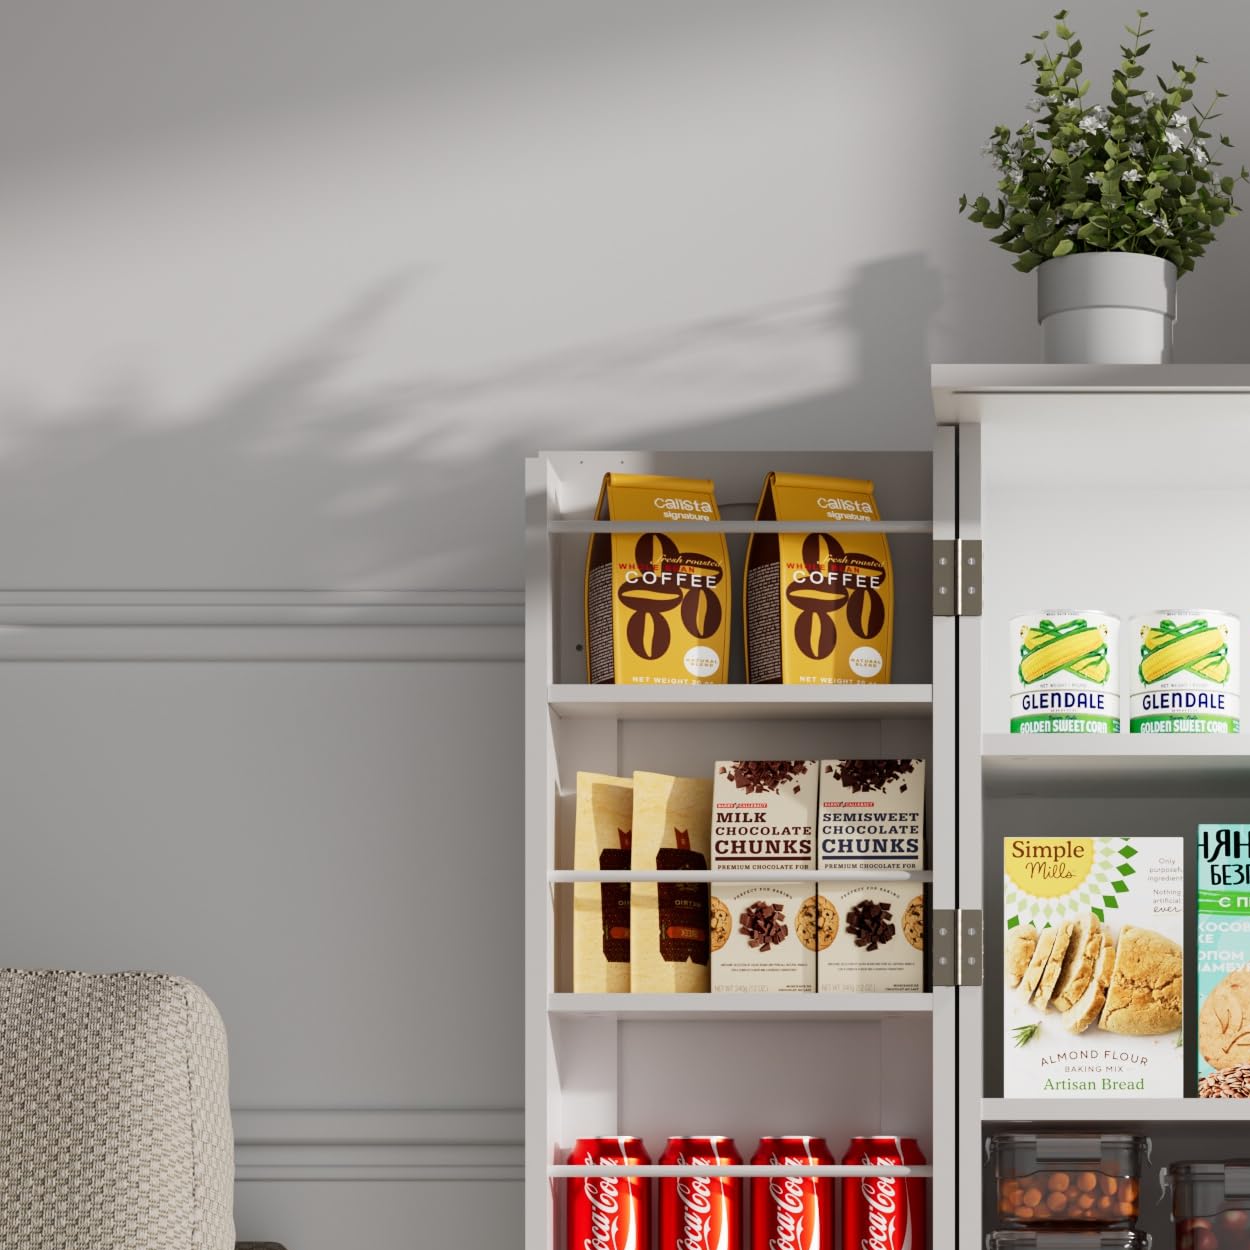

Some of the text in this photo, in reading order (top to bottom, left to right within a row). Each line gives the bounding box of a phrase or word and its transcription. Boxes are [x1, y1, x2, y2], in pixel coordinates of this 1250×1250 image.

[625, 570, 717, 588] COFFEE
[793, 570, 880, 588] COFFEE
[1022, 692, 1105, 710] GLENDALE
[1142, 692, 1225, 710] GLENDALE
[1052, 719, 1085, 733] SWEET
[1173, 719, 1205, 733] SWEET
[716, 812, 766, 822] MILK
[822, 813, 919, 822] SEMISWEET
[715, 827, 812, 836] CHOCOLATE
[822, 825, 919, 834] CHOCOLATE
[715, 839, 812, 854] CHUNKS
[821, 838, 919, 853] CHUNKS
[1012, 841, 1084, 862] Simple
[1158, 857, 1176, 865] Only
[1025, 861, 1077, 880] Mills
[1153, 905, 1182, 913] ever
[1219, 896, 1231, 908] С
[1041, 1050, 1149, 1066] ALMOND FLOUR
[1044, 1078, 1145, 1090] Artisan Bread
